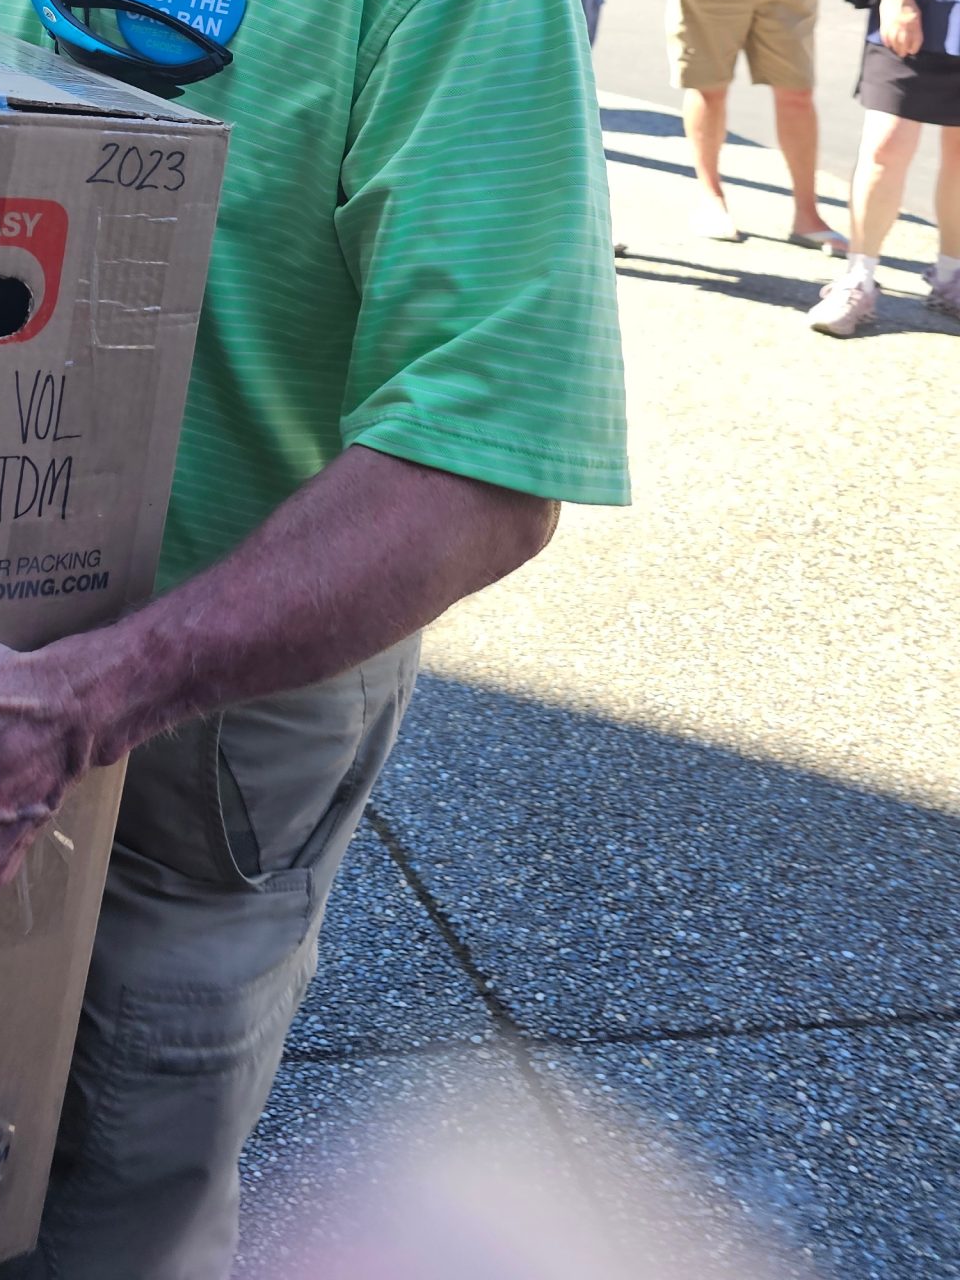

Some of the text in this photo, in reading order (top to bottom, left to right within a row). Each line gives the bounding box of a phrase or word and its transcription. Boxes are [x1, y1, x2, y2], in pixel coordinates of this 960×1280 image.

[177, 10, 223, 37] BAN
[85, 142, 187, 192] 2023
[15, 370, 82, 444] VOL
[15, 549, 102, 576] PACKING
